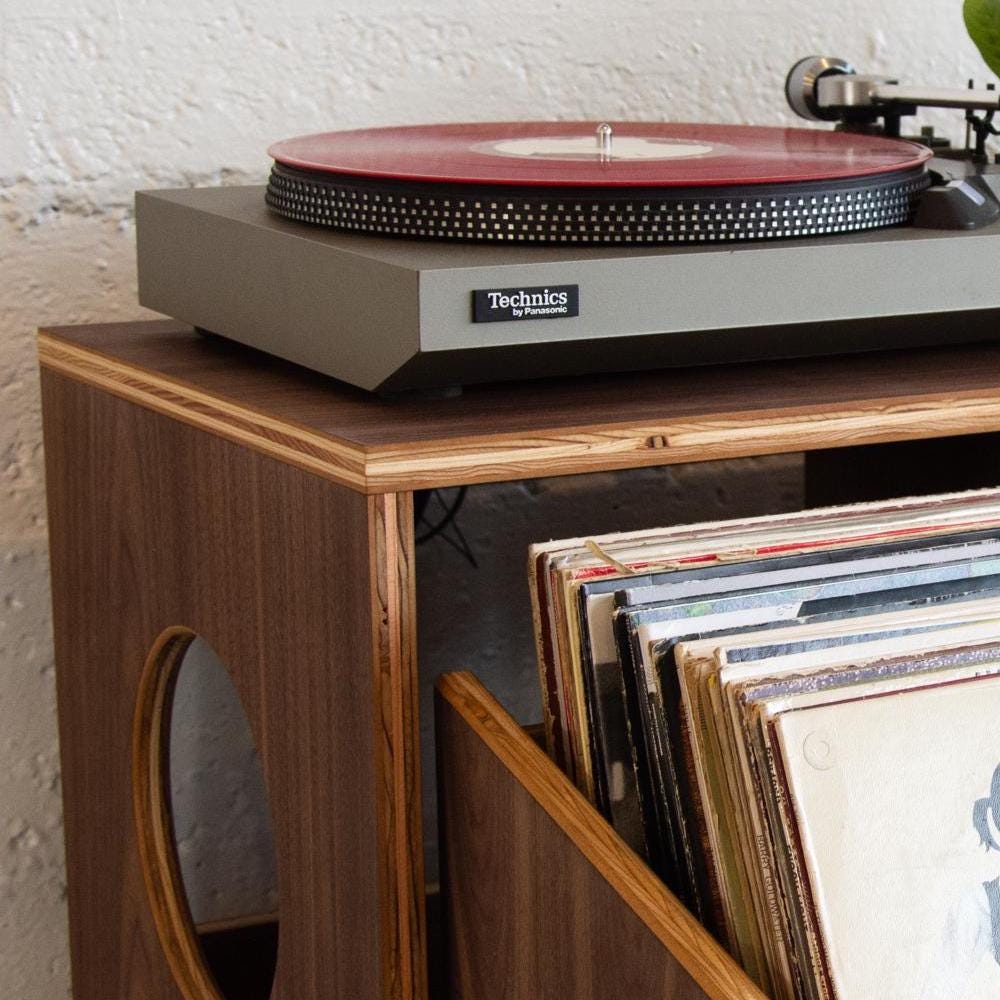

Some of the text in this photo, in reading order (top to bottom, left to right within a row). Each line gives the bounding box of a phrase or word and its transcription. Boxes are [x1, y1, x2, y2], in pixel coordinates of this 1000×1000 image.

[488, 289, 568, 309] Technics
[512, 305, 568, 317] by Panasonic
